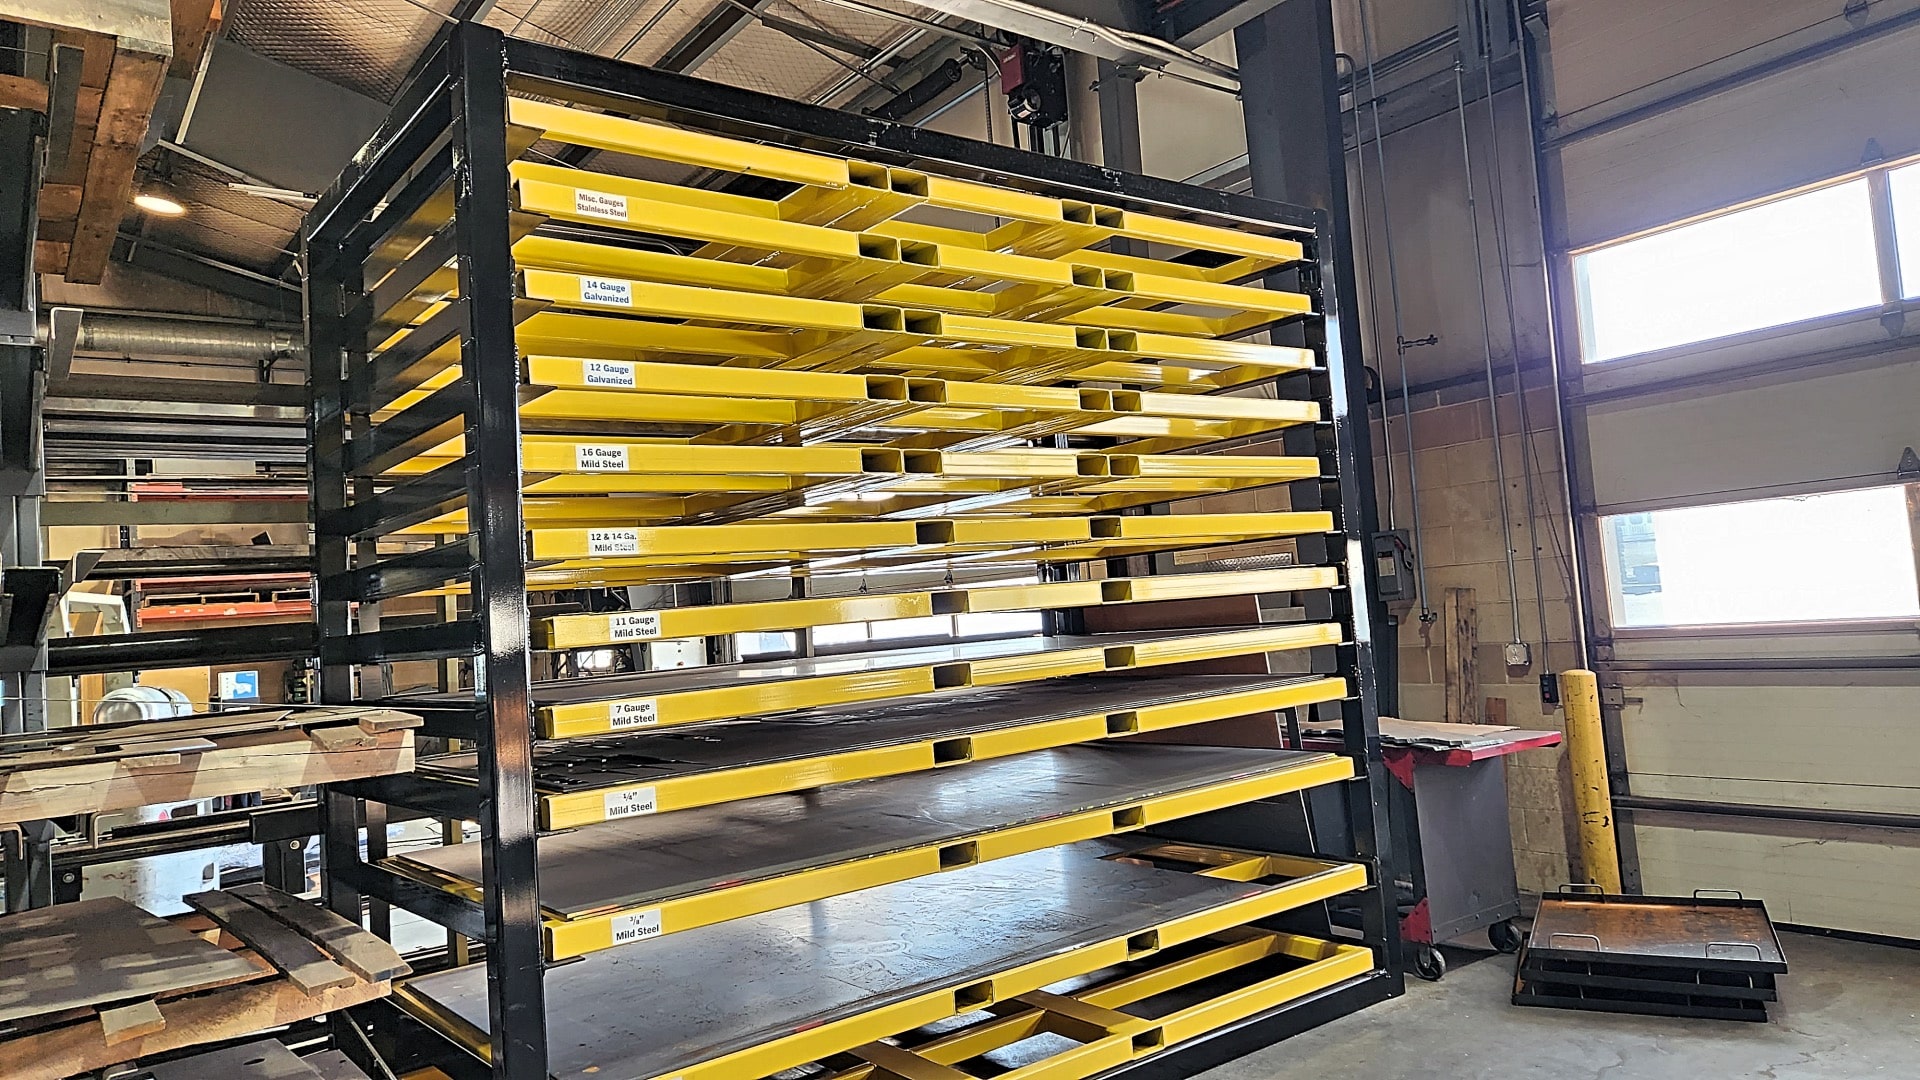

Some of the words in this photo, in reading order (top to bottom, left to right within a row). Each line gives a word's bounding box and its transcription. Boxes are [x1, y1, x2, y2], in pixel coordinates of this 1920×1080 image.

[579, 193, 597, 203] Misc.
[599, 197, 624, 208] Gauges
[577, 203, 608, 215] Stainless
[610, 209, 627, 218] Steel
[600, 282, 626, 293] Gauge
[584, 292, 629, 304] Galvanized
[590, 363, 601, 371] 12
[603, 364, 629, 375] Gauge
[587, 375, 633, 385] Galvanized
[582, 448, 593, 457] 16
[595, 448, 622, 459] Gauge
[581, 460, 600, 468] Mild
[602, 460, 624, 468] Steel
[591, 533, 602, 541] 12
[624, 532, 637, 540] Ga.
[594, 544, 613, 552] Mild
[615, 617, 627, 626] 11
[628, 616, 655, 625] Gauge
[614, 628, 634, 638] Mild
[635, 626, 657, 636] Steel
[616, 705, 622, 714] 7
[624, 702, 650, 713] Gauge
[612, 716, 632, 727] Mild
[633, 713, 655, 724] Steel
[609, 805, 629, 816] Mild
[630, 801, 653, 812] Steel
[616, 929, 635, 941] Mild
[637, 923, 659, 936] Steel
